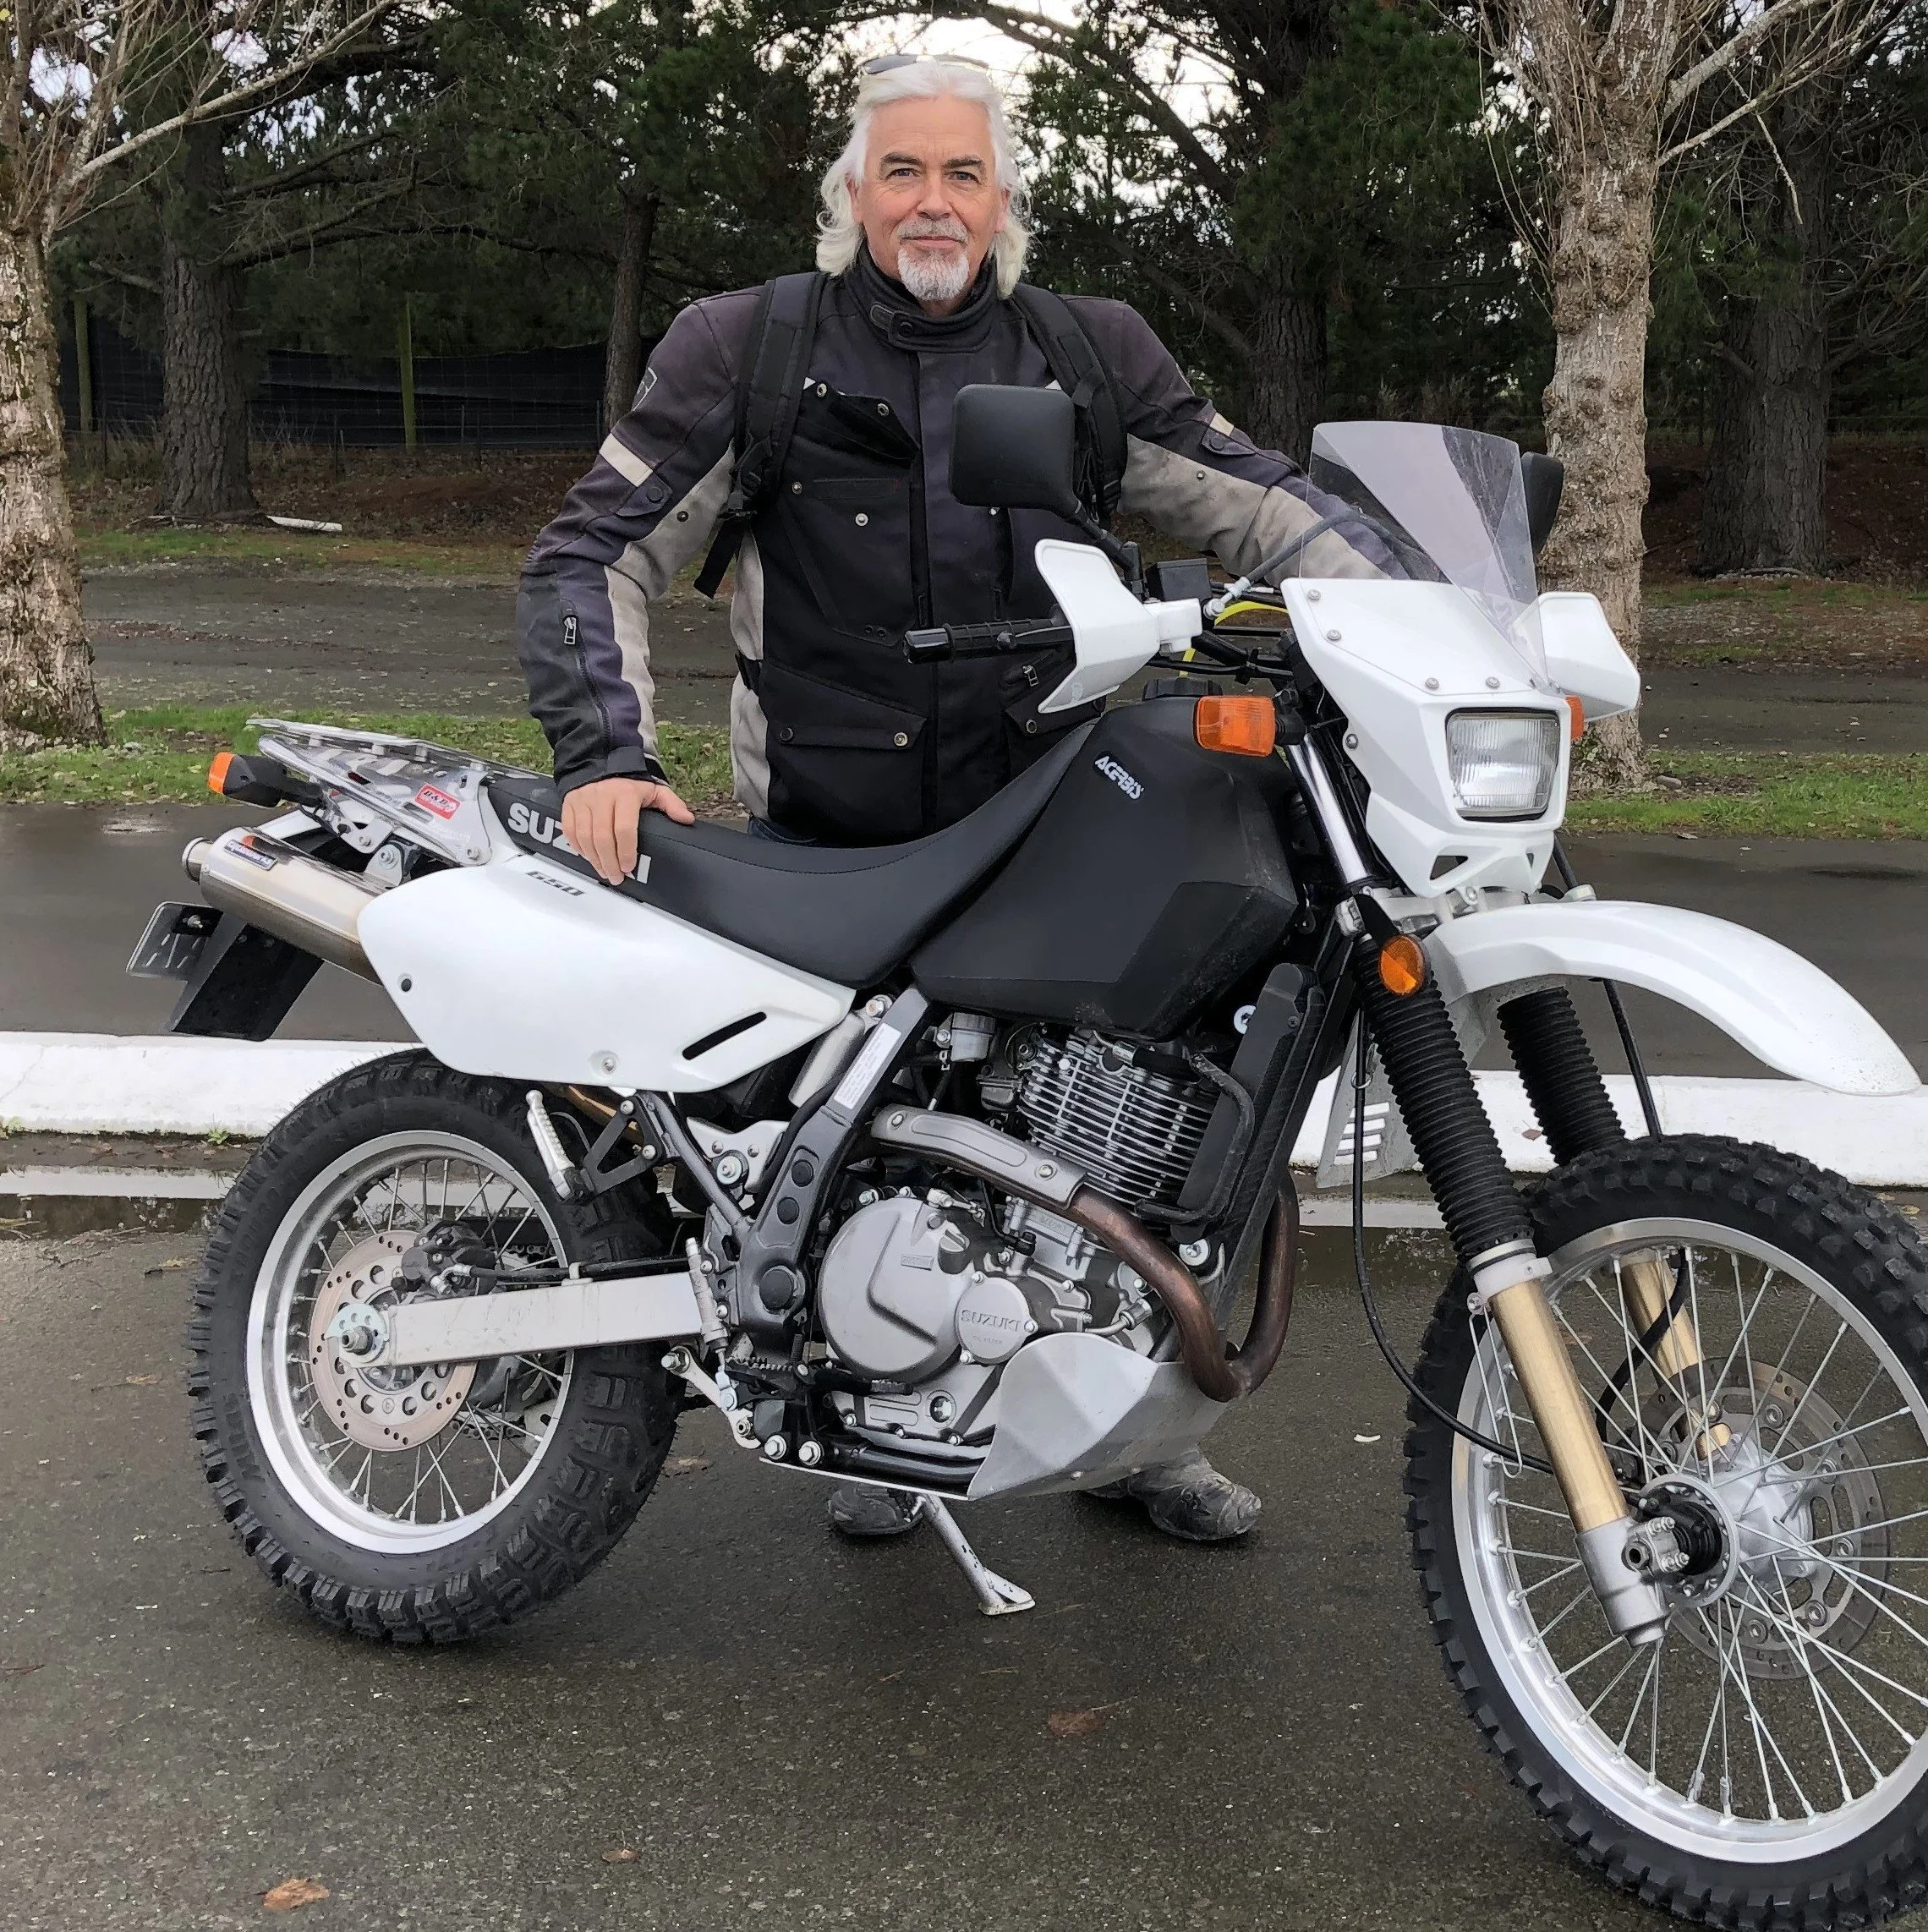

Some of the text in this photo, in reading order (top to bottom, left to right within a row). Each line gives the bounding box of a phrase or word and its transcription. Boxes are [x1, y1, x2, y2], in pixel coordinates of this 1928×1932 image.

[1094, 755, 1145, 800] ACERBIS
[507, 802, 652, 884] SUZI
[525, 870, 586, 896] 650
[961, 1309, 1022, 1333] SUZUKI
